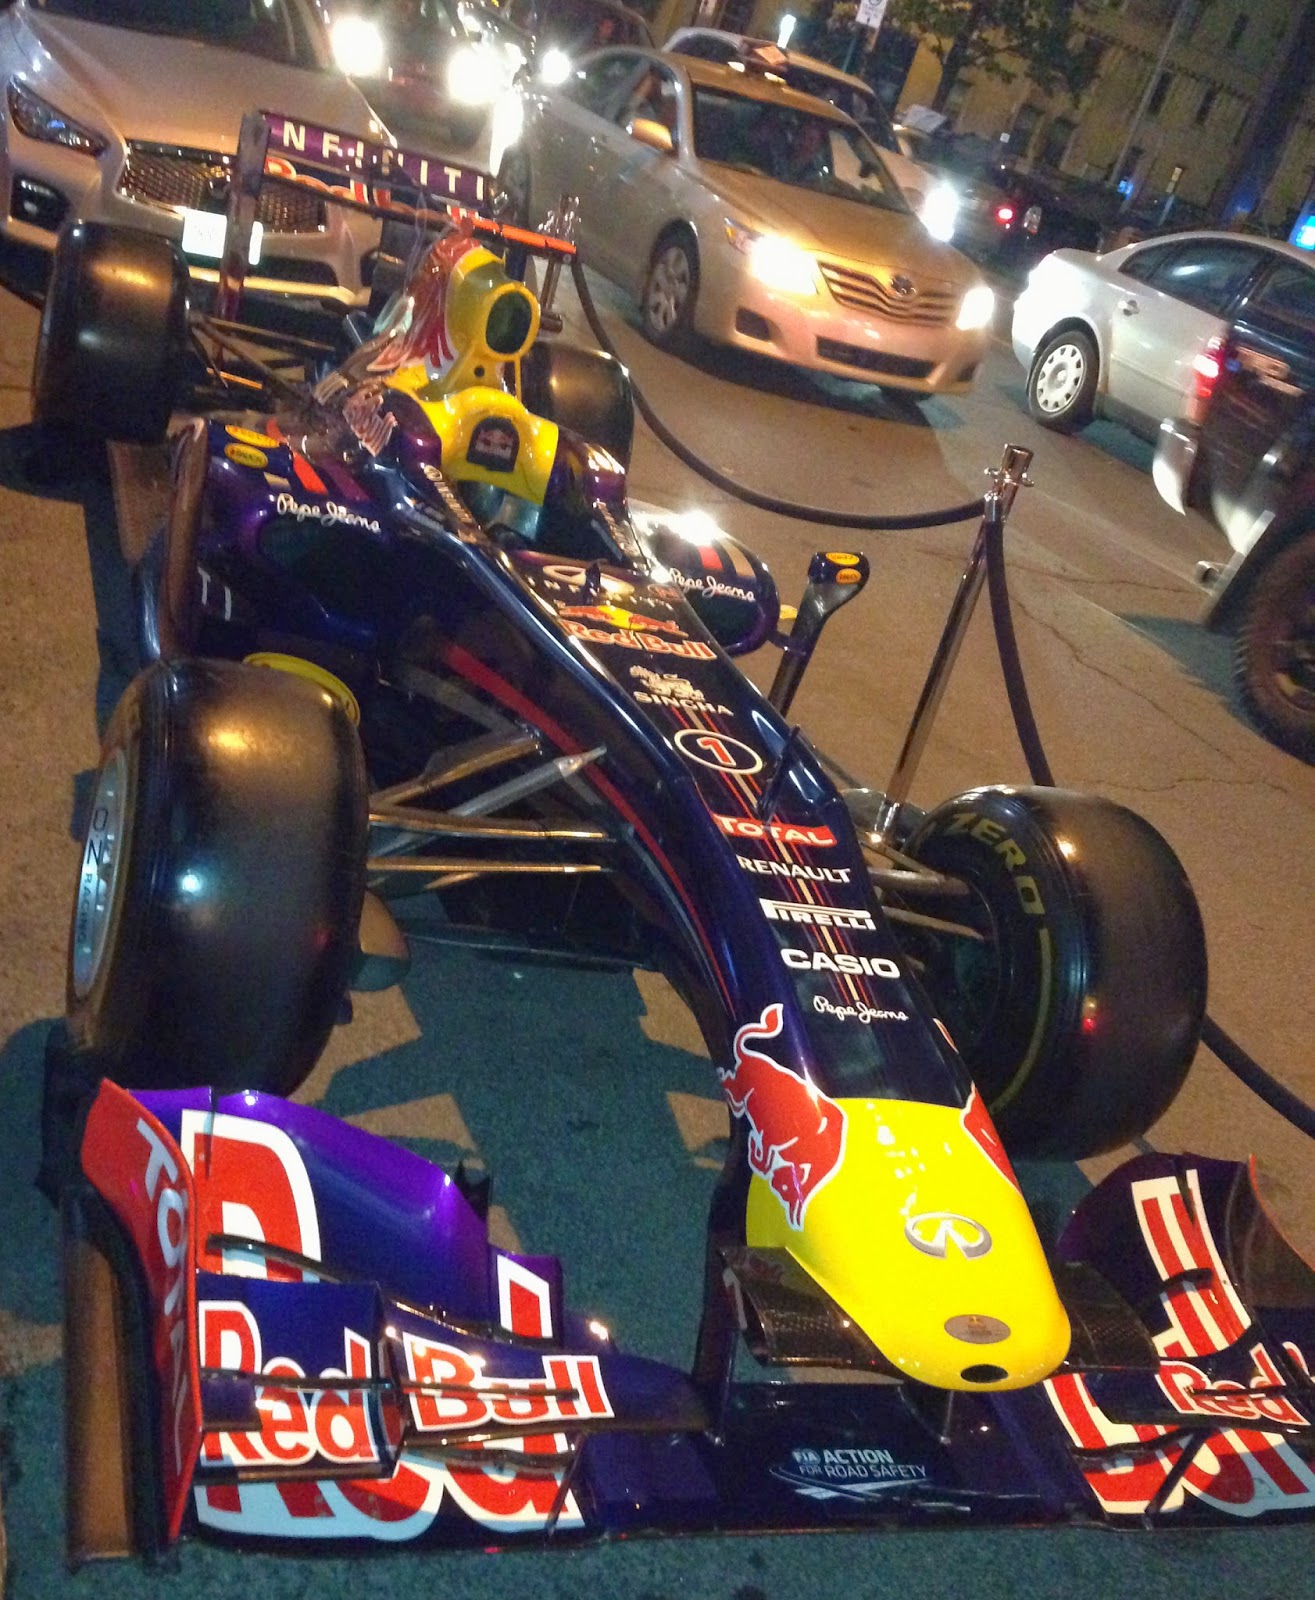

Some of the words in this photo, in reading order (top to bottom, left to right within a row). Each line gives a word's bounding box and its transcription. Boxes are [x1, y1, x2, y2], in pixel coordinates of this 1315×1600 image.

[275, 494, 323, 522] Pepe
[701, 578, 756, 602] Jeans
[559, 619, 643, 650] Red
[636, 632, 718, 661] Bull
[696, 737, 737, 767] 1
[719, 814, 833, 845] TOTAL
[736, 855, 851, 883] RENAULT
[945, 812, 1046, 916] ZERO
[759, 898, 876, 931] PIRELLI
[780, 948, 900, 979] CASIO
[813, 995, 857, 1019] Pepe
[851, 1001, 910, 1024] Jeans
[403, 1332, 614, 1431] Bull
[822, 1449, 894, 1464] ACTION
[824, 1465, 869, 1478] ROAD
[869, 1465, 927, 1478] SAFETY
